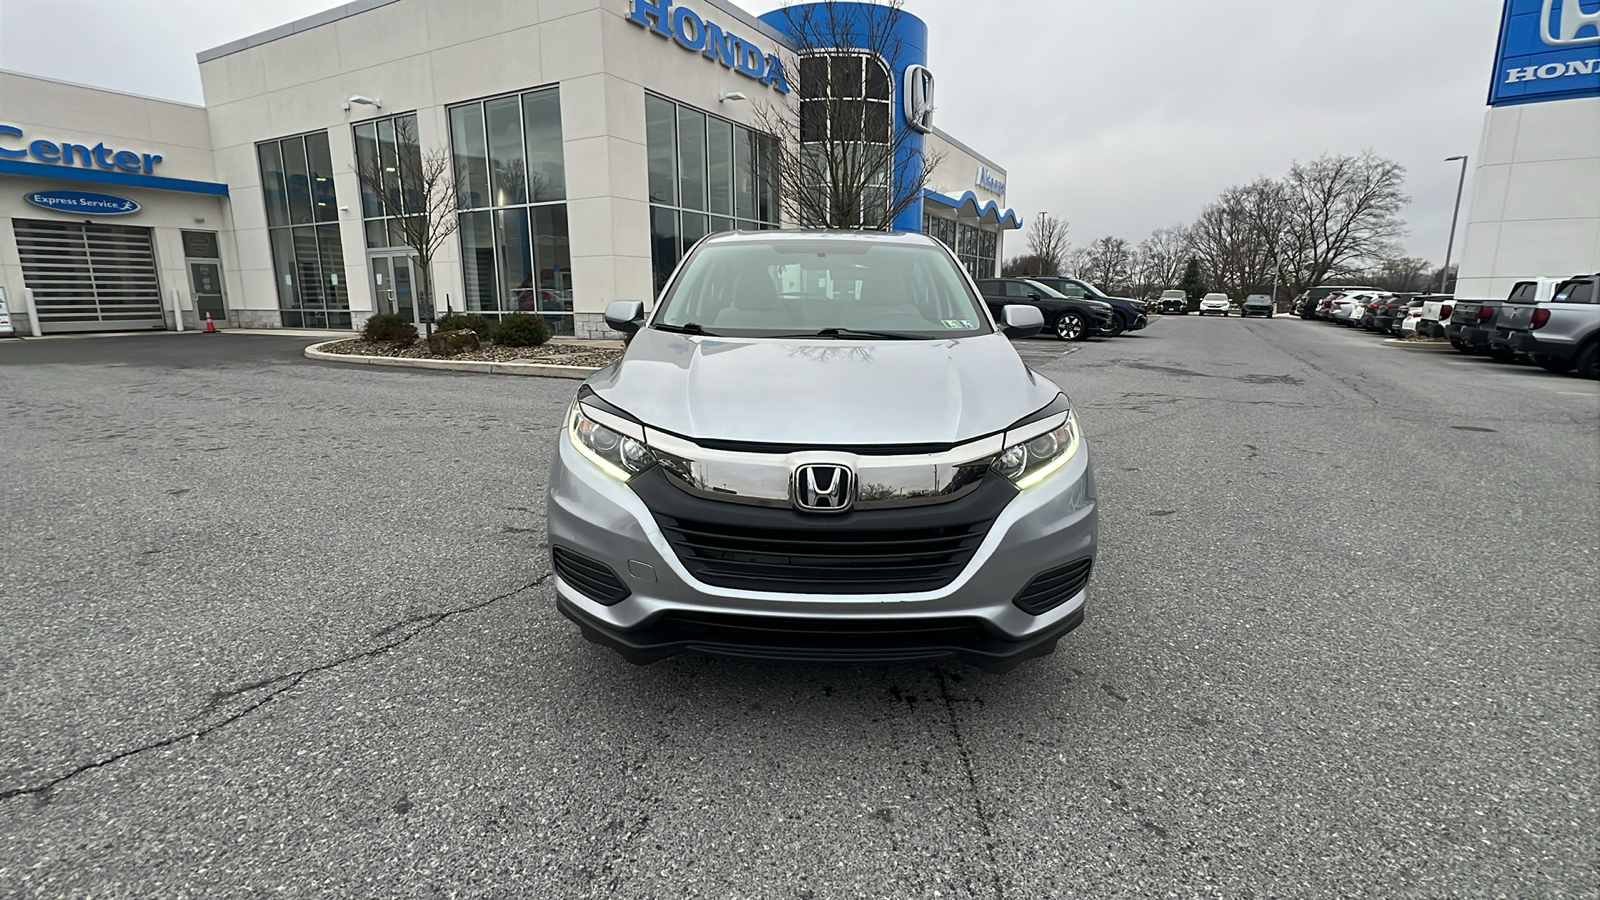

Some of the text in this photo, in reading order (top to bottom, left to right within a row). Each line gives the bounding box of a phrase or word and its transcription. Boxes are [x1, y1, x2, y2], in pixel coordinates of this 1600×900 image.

[628, 0, 790, 94] HONDA
[1505, 58, 1600, 84] HON
[34, 194, 119, 209] Express Service
